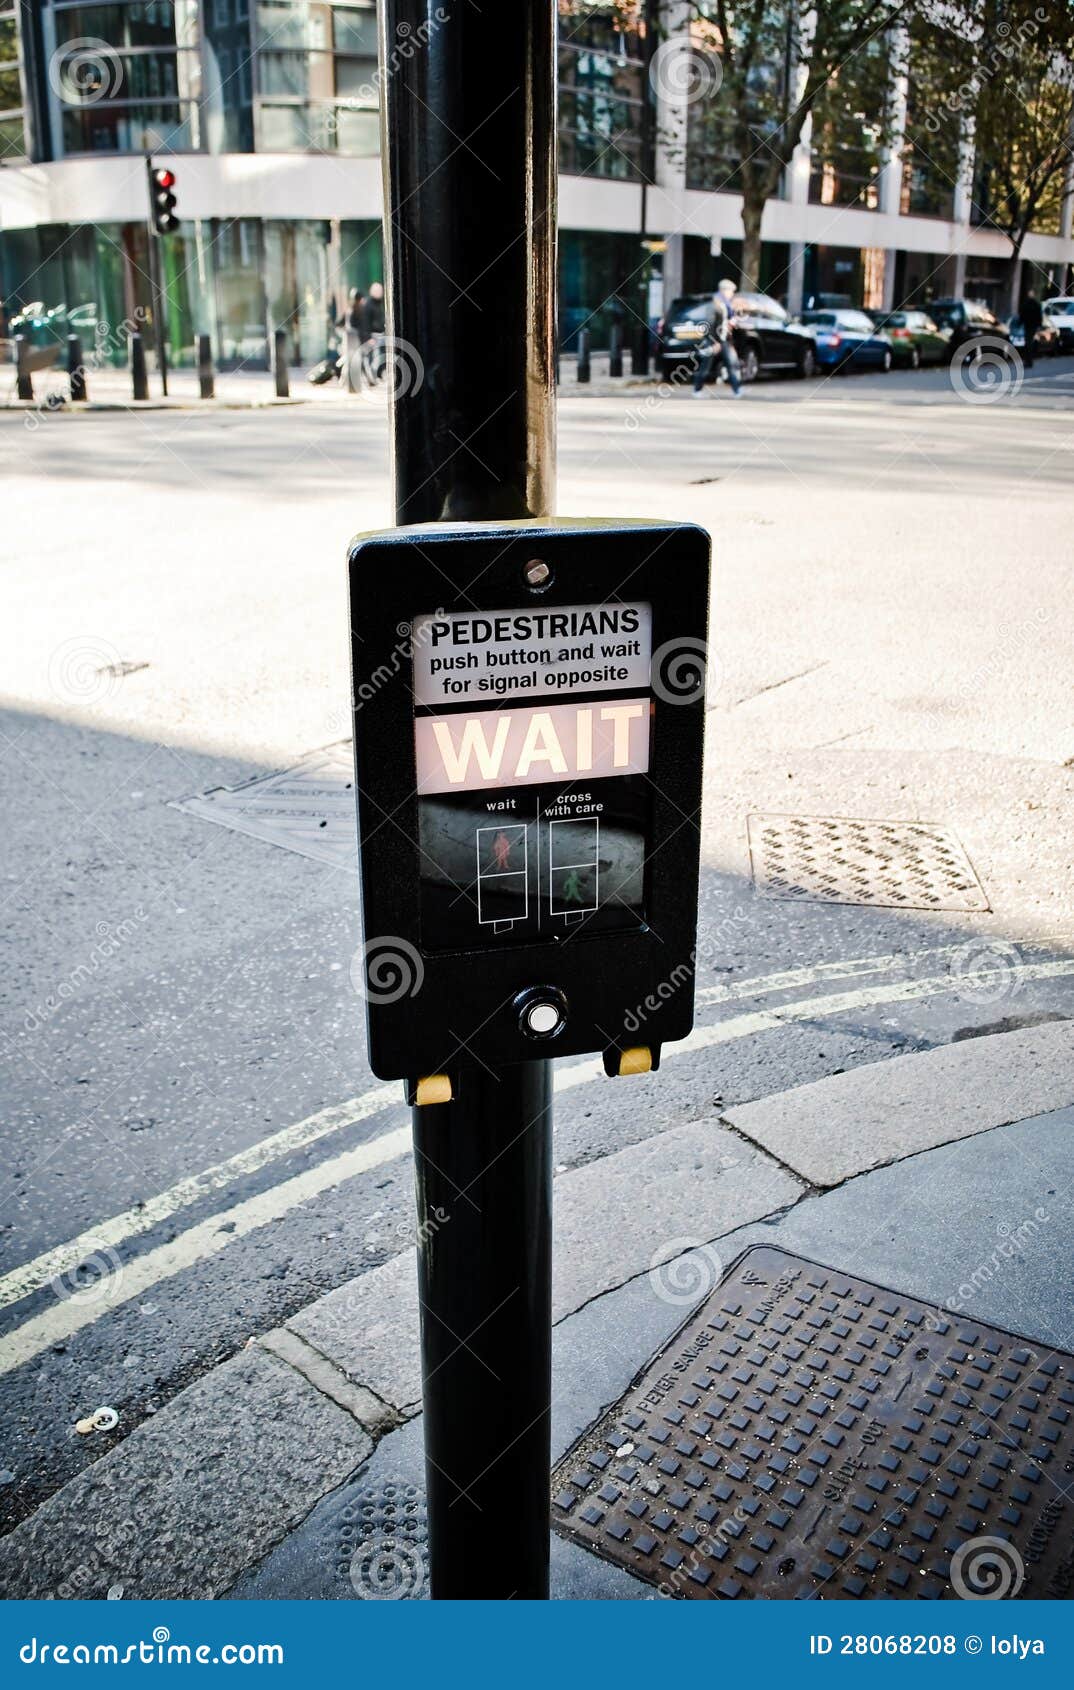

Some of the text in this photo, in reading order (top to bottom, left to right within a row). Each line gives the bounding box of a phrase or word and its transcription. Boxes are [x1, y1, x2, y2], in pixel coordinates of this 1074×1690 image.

[431, 608, 640, 647] PEDESTRIANS
[430, 640, 641, 675] push button and wait
[442, 665, 629, 695] for signal opposite
[431, 704, 644, 784] WAIT
[486, 798, 517, 811] wait
[544, 802, 604, 817] with care
[556, 792, 592, 804] cross
[672, 1330, 715, 1372] SAVAGE
